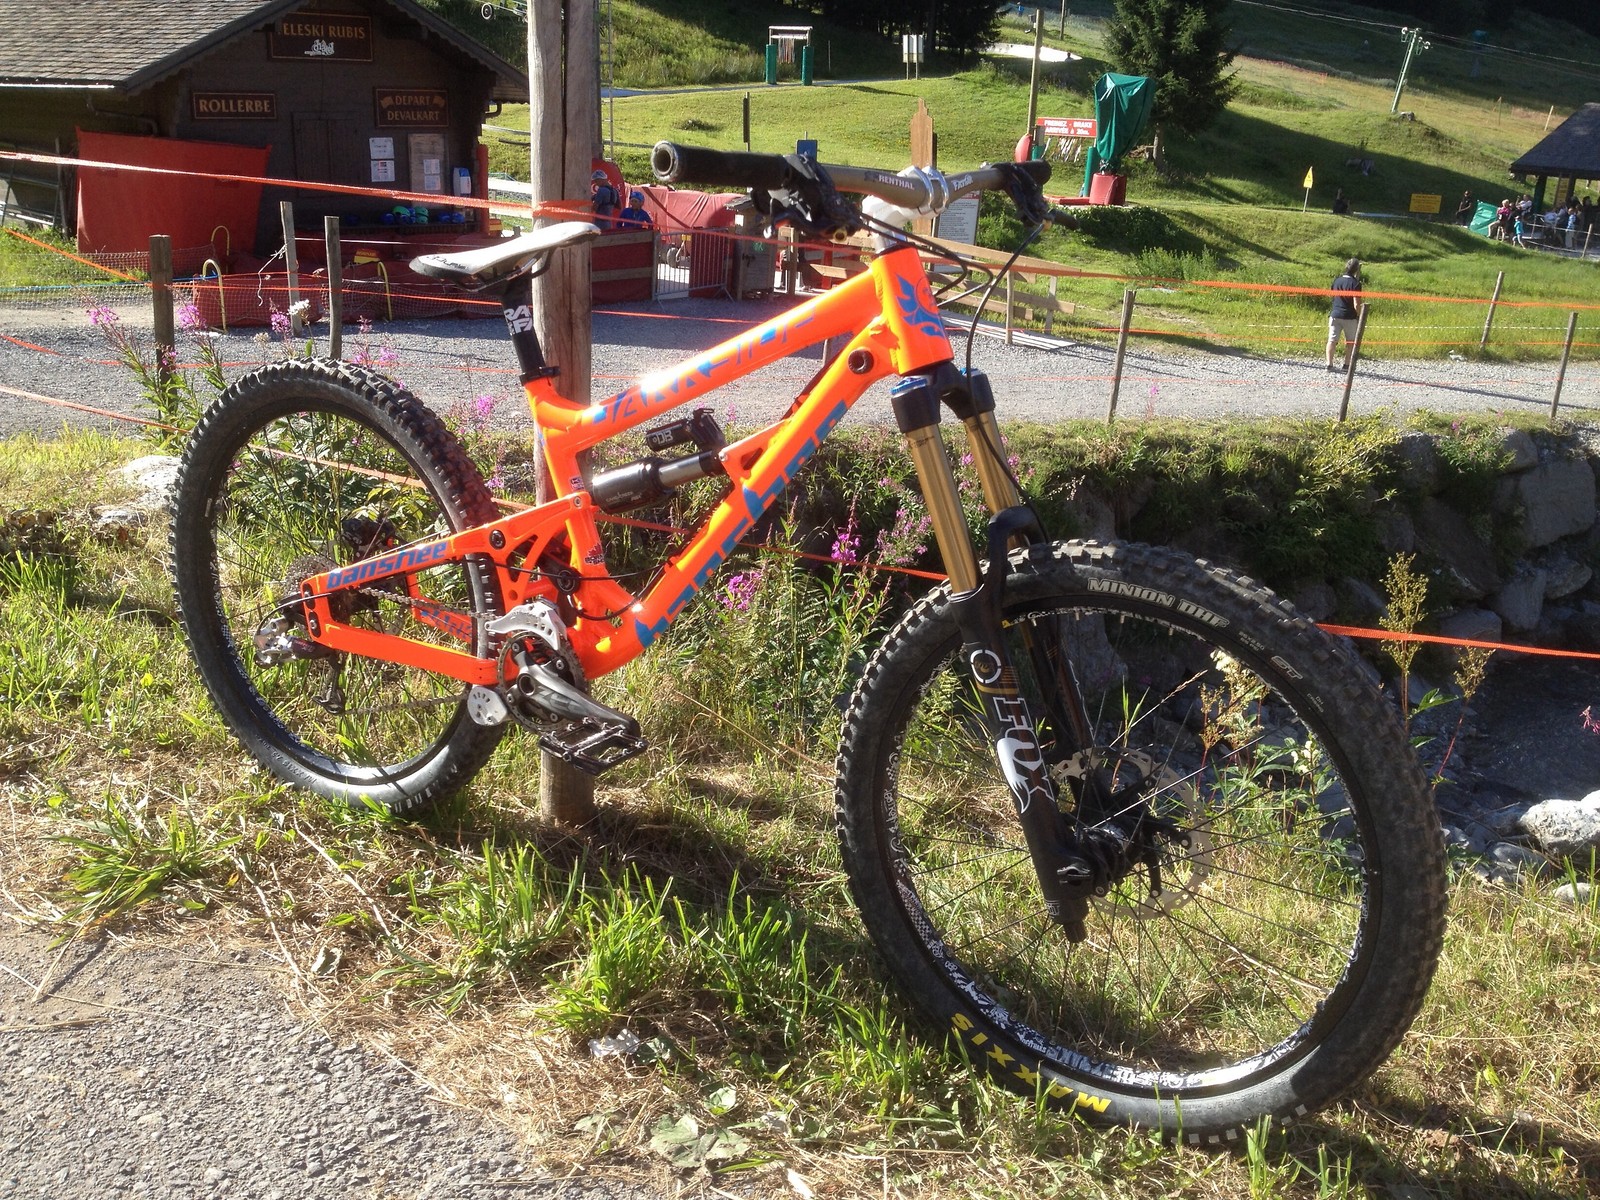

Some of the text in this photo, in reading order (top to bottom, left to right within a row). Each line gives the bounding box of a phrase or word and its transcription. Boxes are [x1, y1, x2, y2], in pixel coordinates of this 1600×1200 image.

[278, 22, 365, 39] ELESKI RUBIS
[198, 99, 271, 113] ROLLERBE
[395, 95, 430, 106] DEPART
[387, 110, 440, 121] DEVALKART
[878, 174, 916, 191] RENTHAL
[1087, 577, 1230, 628] MINION DHF
[993, 697, 1055, 814] FOX
[951, 1012, 1112, 1113] MAXXIS
